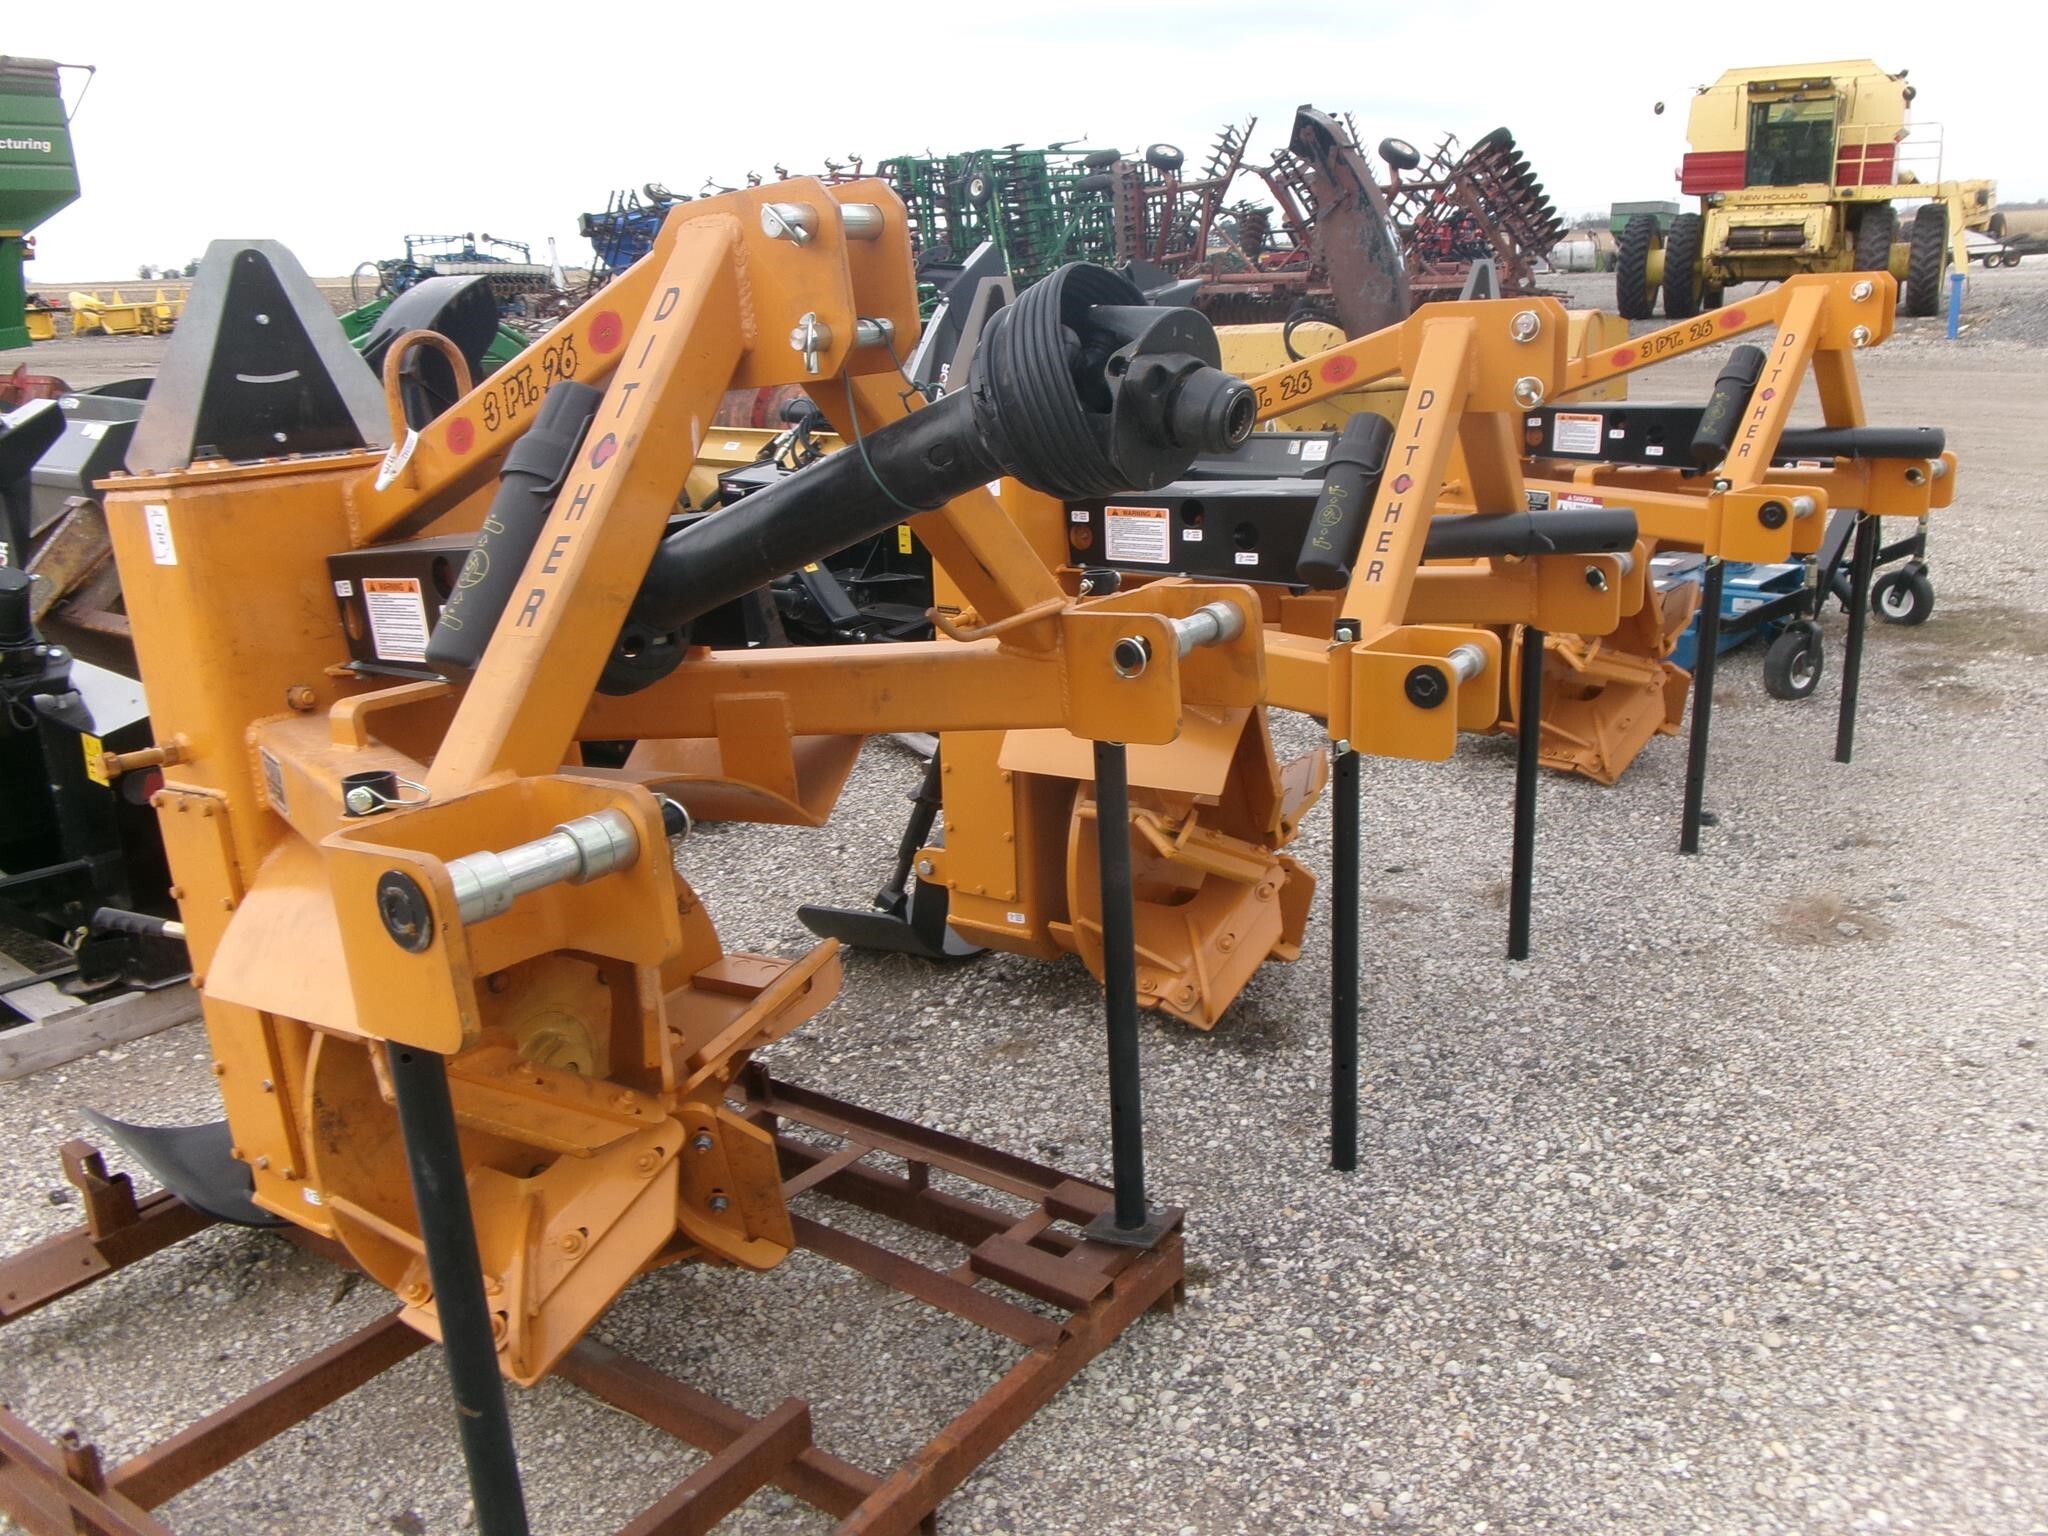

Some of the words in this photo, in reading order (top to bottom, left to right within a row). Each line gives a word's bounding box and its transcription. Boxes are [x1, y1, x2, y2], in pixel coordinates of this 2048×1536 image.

[0, 138, 51, 152] cturing
[1739, 193, 1761, 201] NEW
[1763, 192, 1808, 201] HOLLAND
[1641, 341, 1653, 358] 3
[1656, 332, 1684, 350] PT.
[1690, 319, 1713, 341] 26
[483, 391, 500, 431] 3
[502, 364, 539, 419] PT.
[541, 333, 581, 394] 26
[1279, 370, 1312, 400] 26
[1738, 333, 1796, 458] DITCHER
[516, 287, 680, 627] DITCHER
[1366, 390, 1434, 582] DITCHER
[1122, 509, 1151, 518] WARNING
